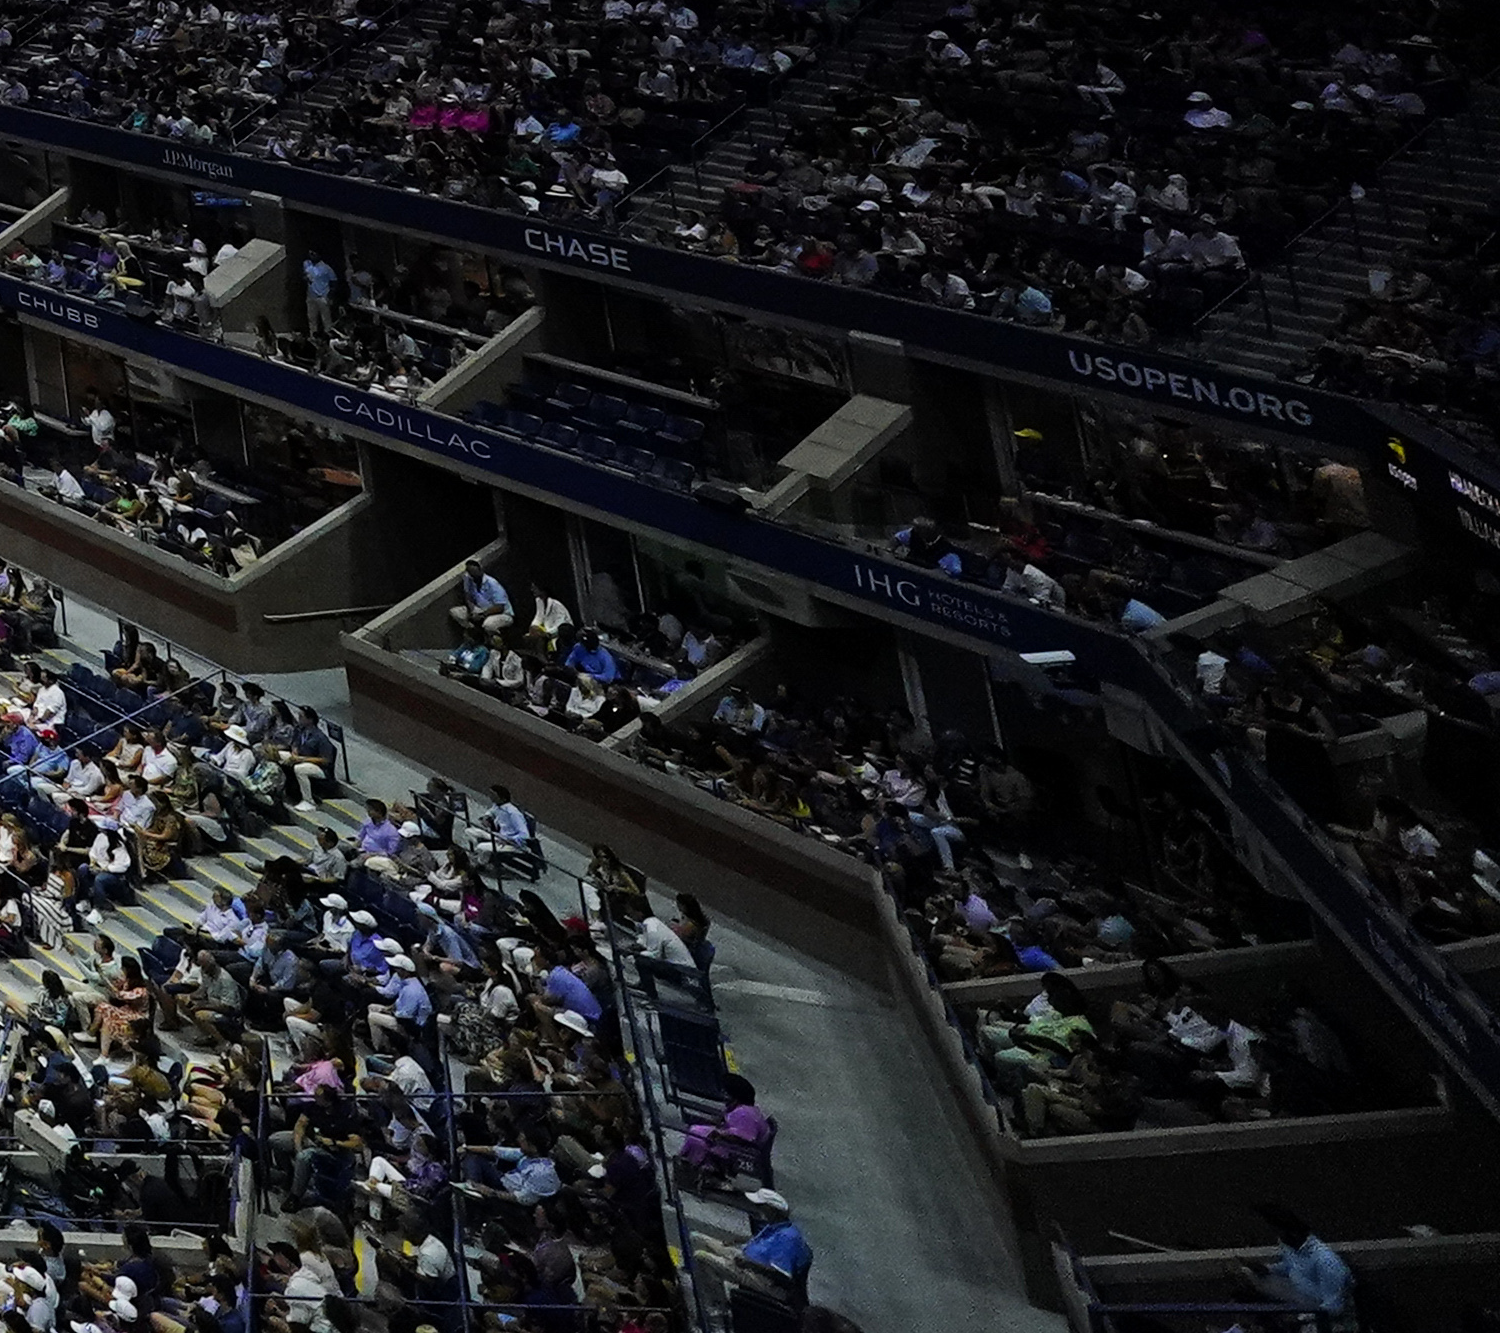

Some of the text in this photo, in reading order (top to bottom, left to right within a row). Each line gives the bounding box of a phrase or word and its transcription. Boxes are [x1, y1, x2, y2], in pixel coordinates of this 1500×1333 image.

[162, 148, 234, 180] J.P.Morgan
[524, 228, 632, 272] CHASE
[17, 290, 98, 329] CHUBB
[1068, 348, 1314, 427] USOPEN.ORG
[333, 393, 493, 460] CADILLAC
[852, 561, 922, 607] IHG
[926, 587, 997, 621] HOTELS
[930, 603, 1013, 639] RESORTS
